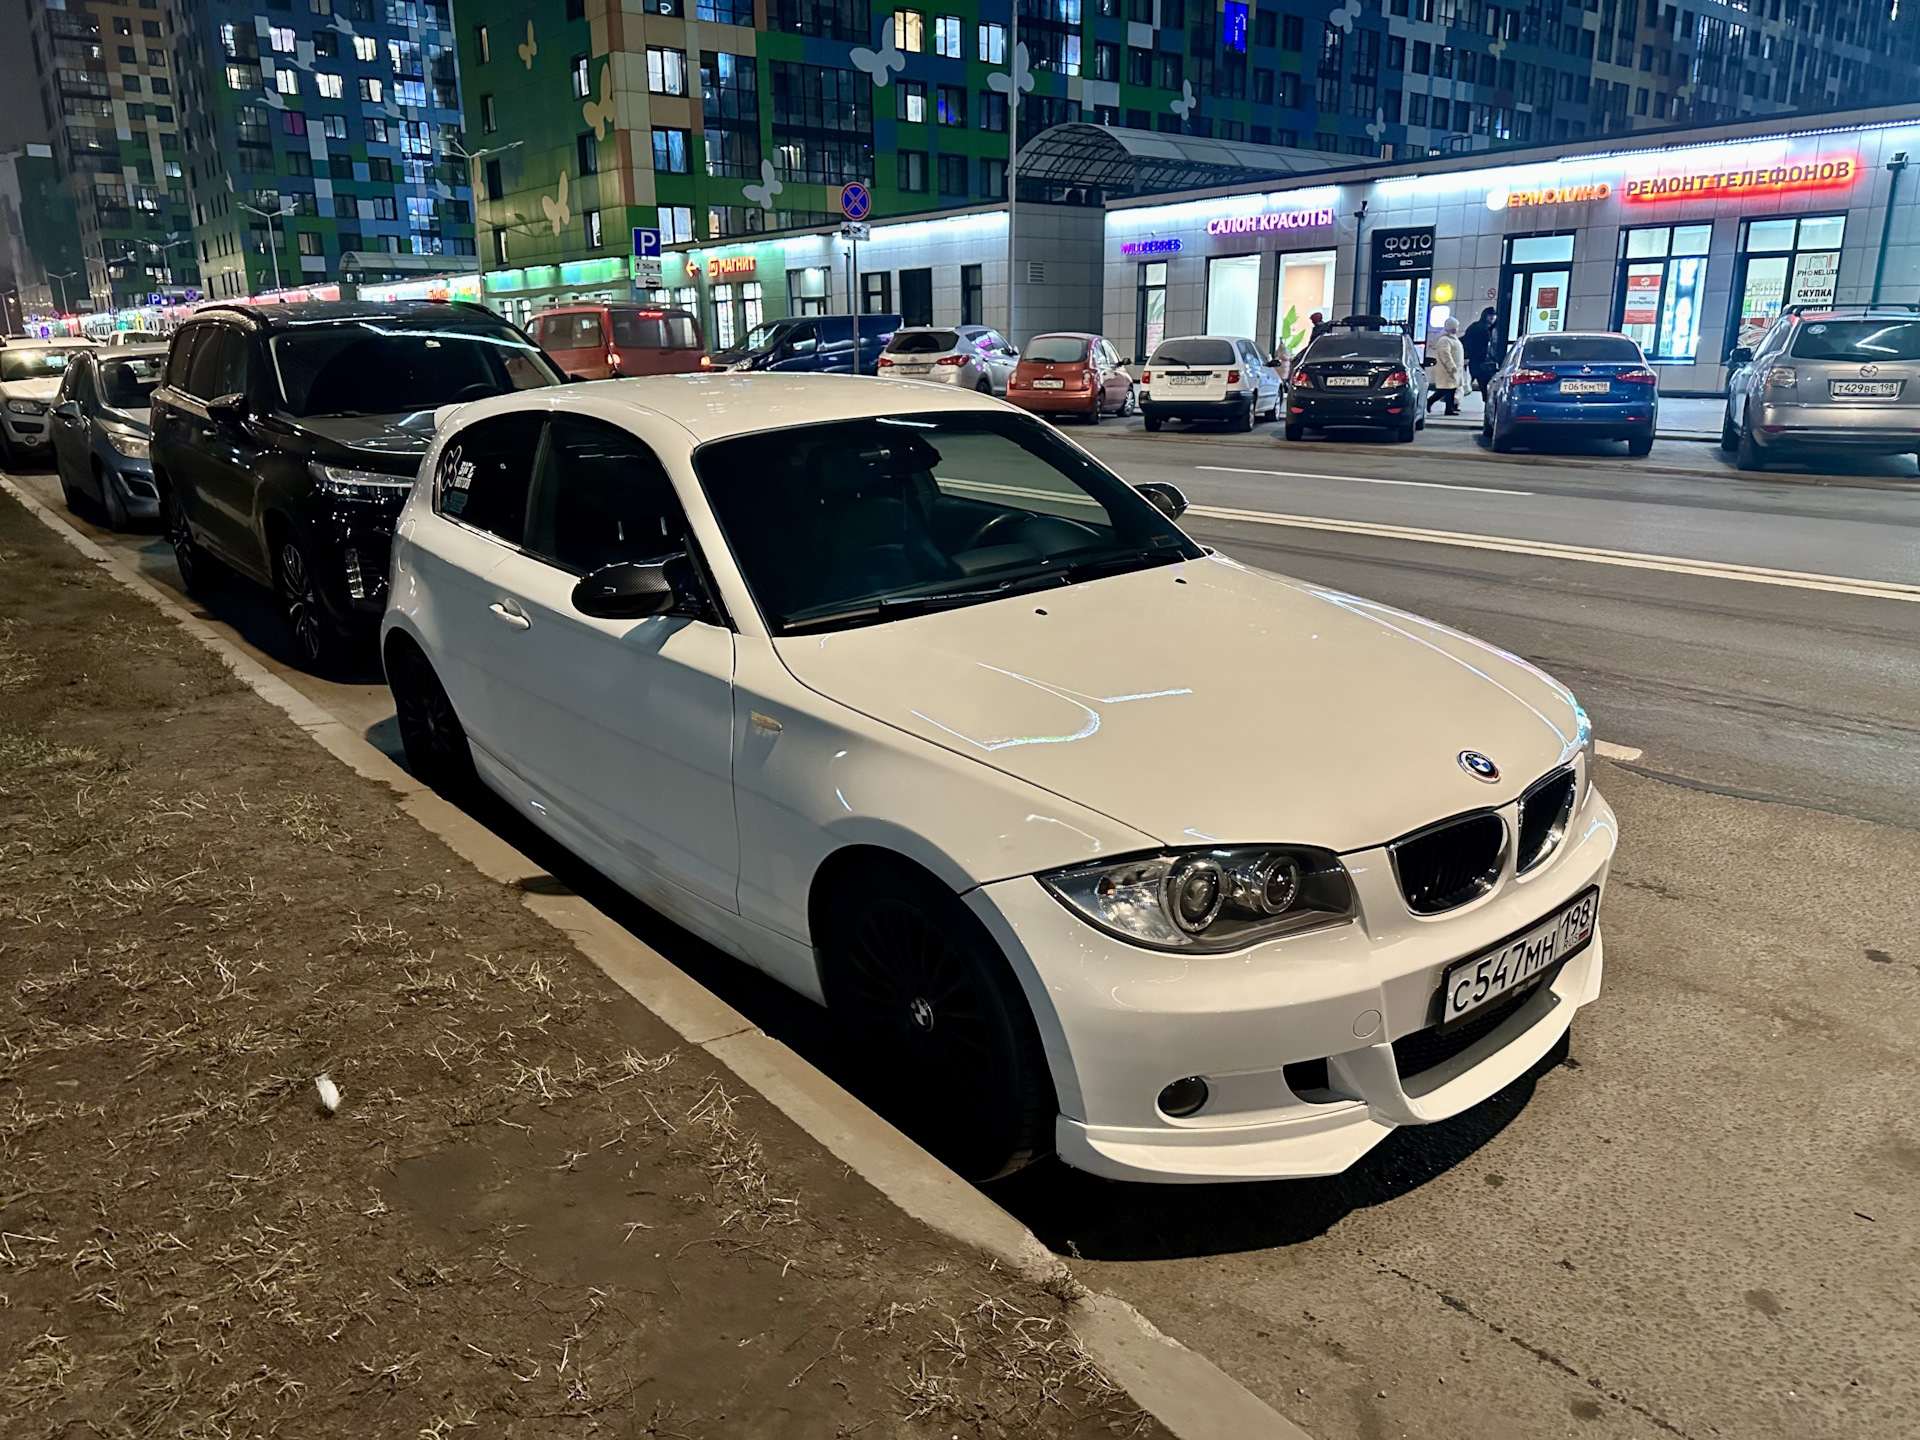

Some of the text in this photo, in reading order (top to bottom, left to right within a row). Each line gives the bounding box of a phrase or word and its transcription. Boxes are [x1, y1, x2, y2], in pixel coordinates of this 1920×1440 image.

[1627, 161, 1850, 197] РЕМОНТ ТЕЛЕФОНОВ
[1508, 184, 1610, 208] ЕРМОЛИНО
[1207, 208, 1334, 236] САЛОН КРАСОТЫ
[640, 231, 656, 255] P
[1121, 239, 1184, 256] WILDBERRIES
[1384, 234, 1432, 251] ФОТО
[719, 255, 756, 273] МАГНИТ
[1797, 289, 1832, 298] СКУПКА
[1563, 383, 1595, 391] Т061КМ
[1838, 383, 1895, 393] Т429ВЕ 198
[1563, 933, 1579, 950] RUS
[1453, 898, 1591, 1013] С547МН 198
